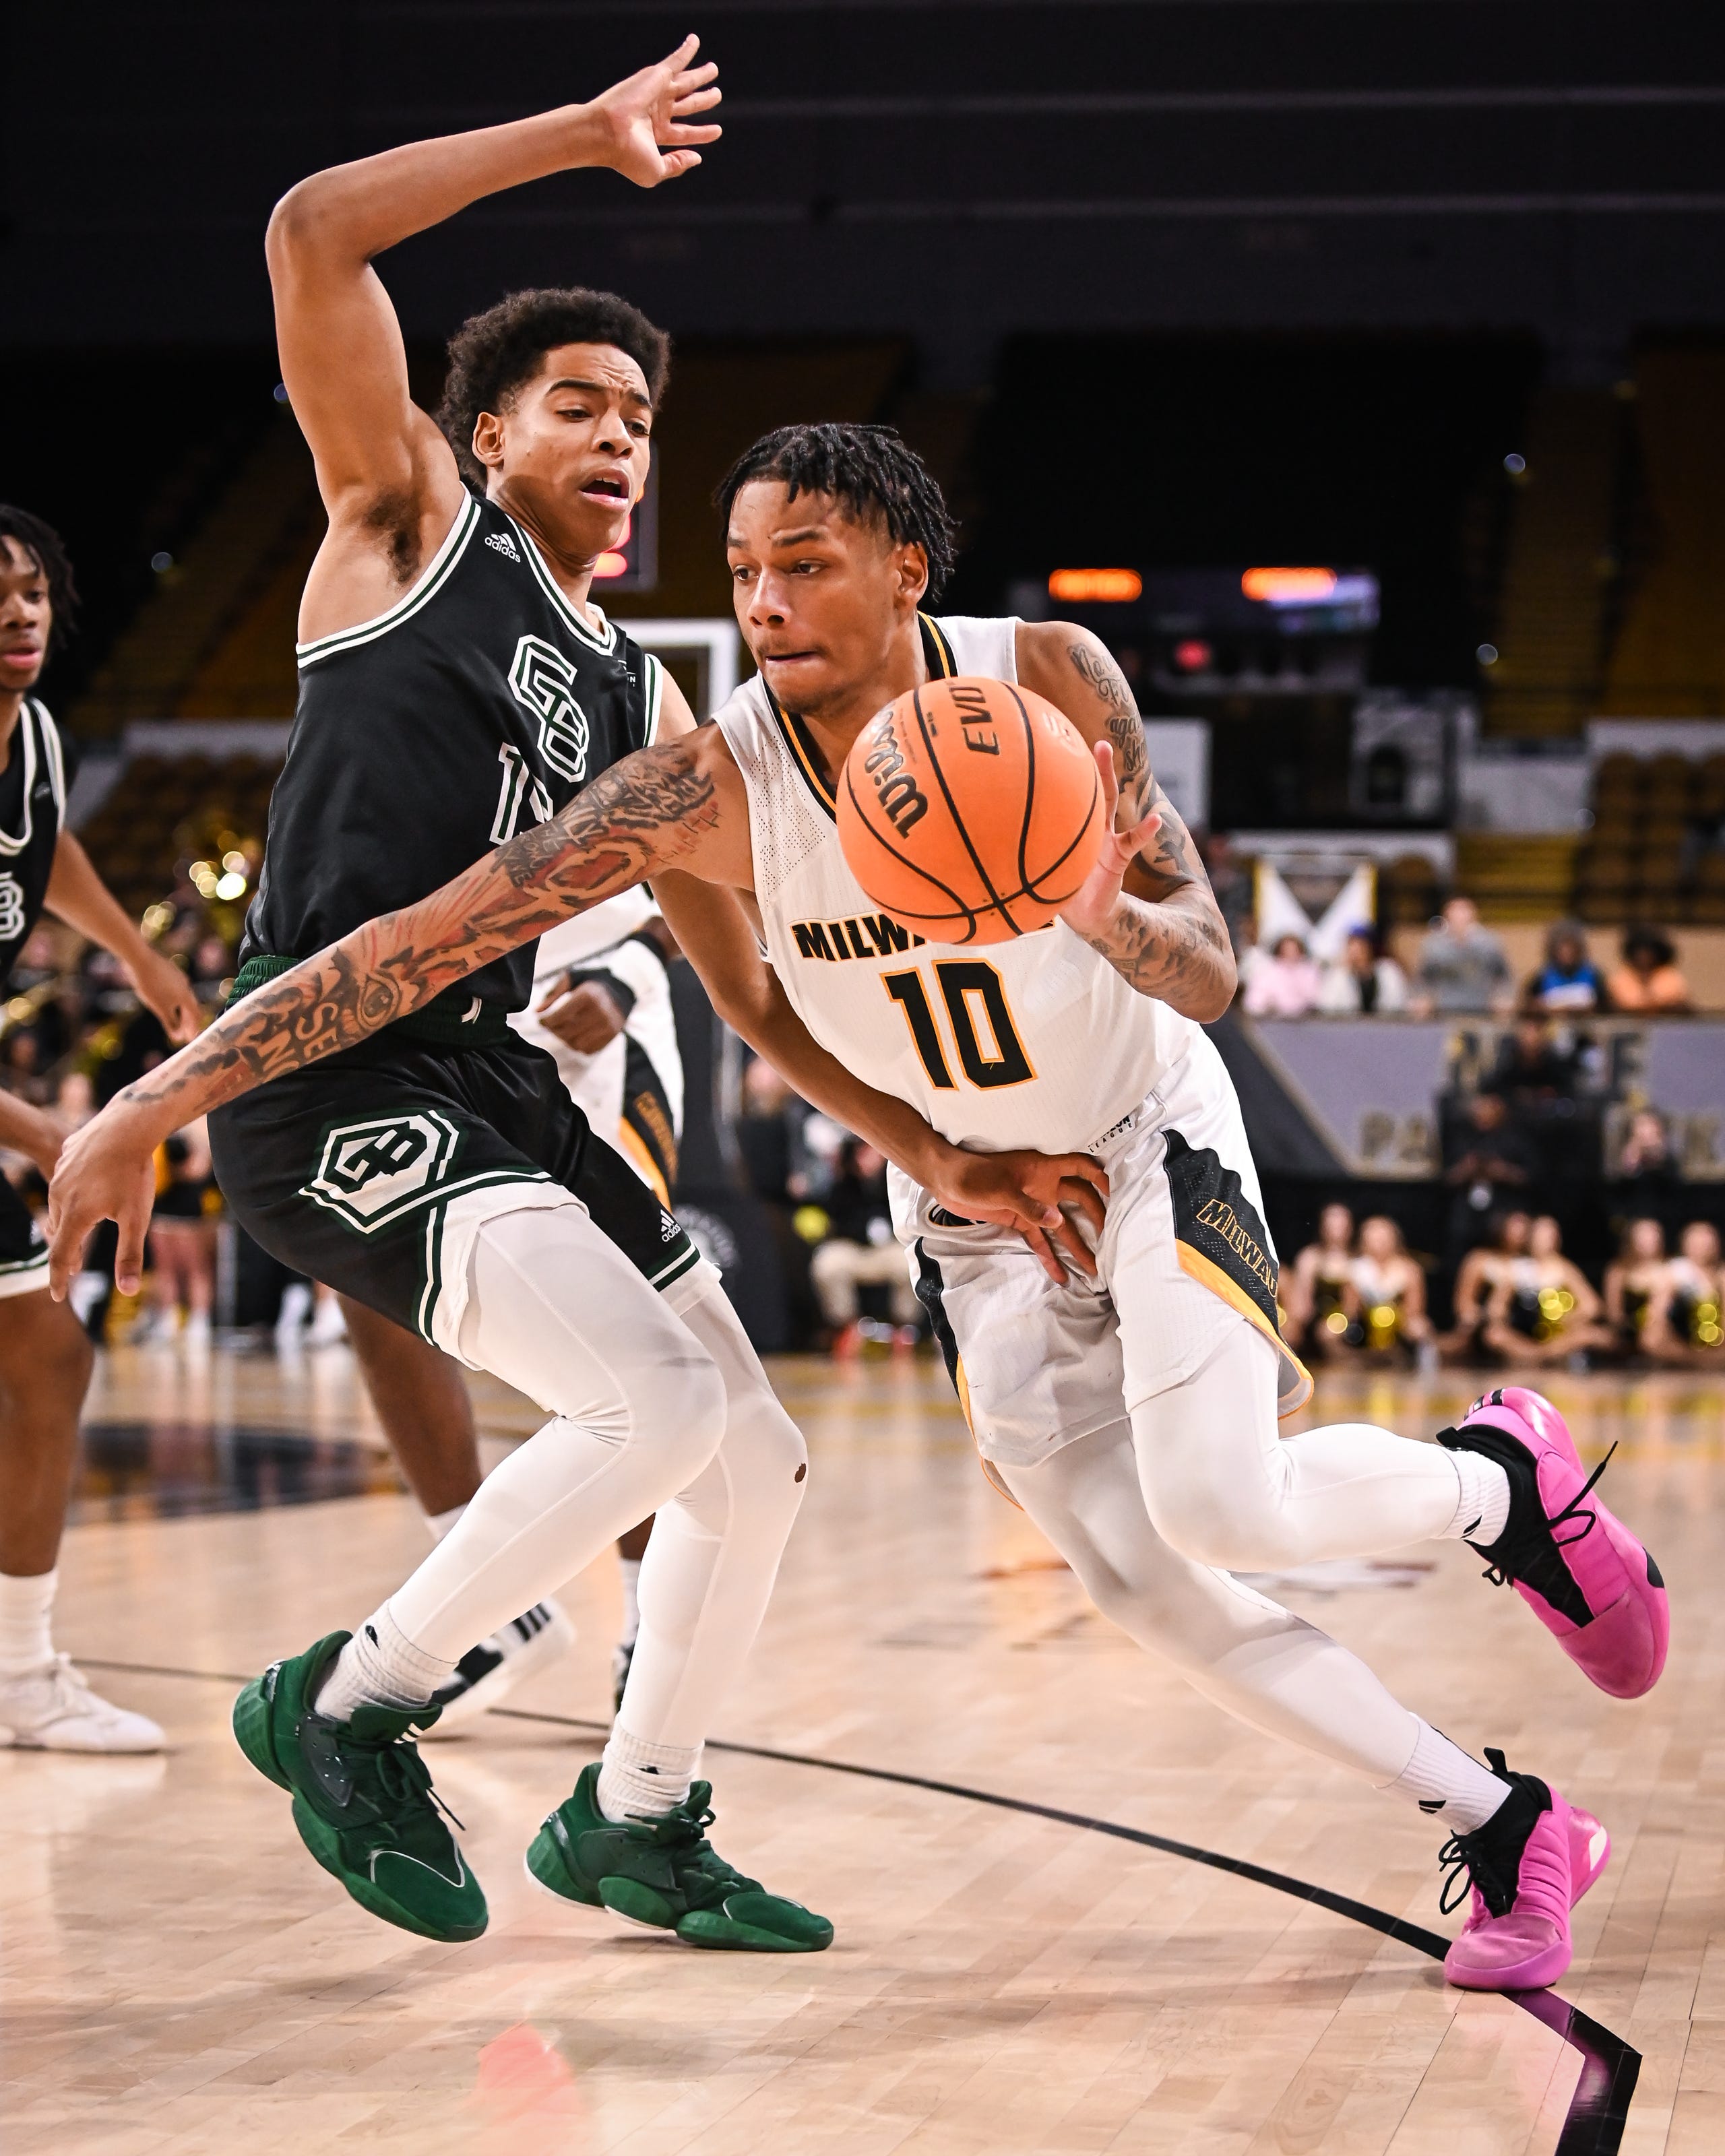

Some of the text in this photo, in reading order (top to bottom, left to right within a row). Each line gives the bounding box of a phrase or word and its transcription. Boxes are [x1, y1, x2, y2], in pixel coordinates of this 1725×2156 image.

[484, 536, 521, 563] adidas
[949, 686, 1000, 755] EVO
[865, 701, 928, 839] Wilso
[880, 957, 1038, 1092] 10
[1089, 1122, 1133, 1153] LEAGUE
[661, 1223, 681, 1242] adidas
